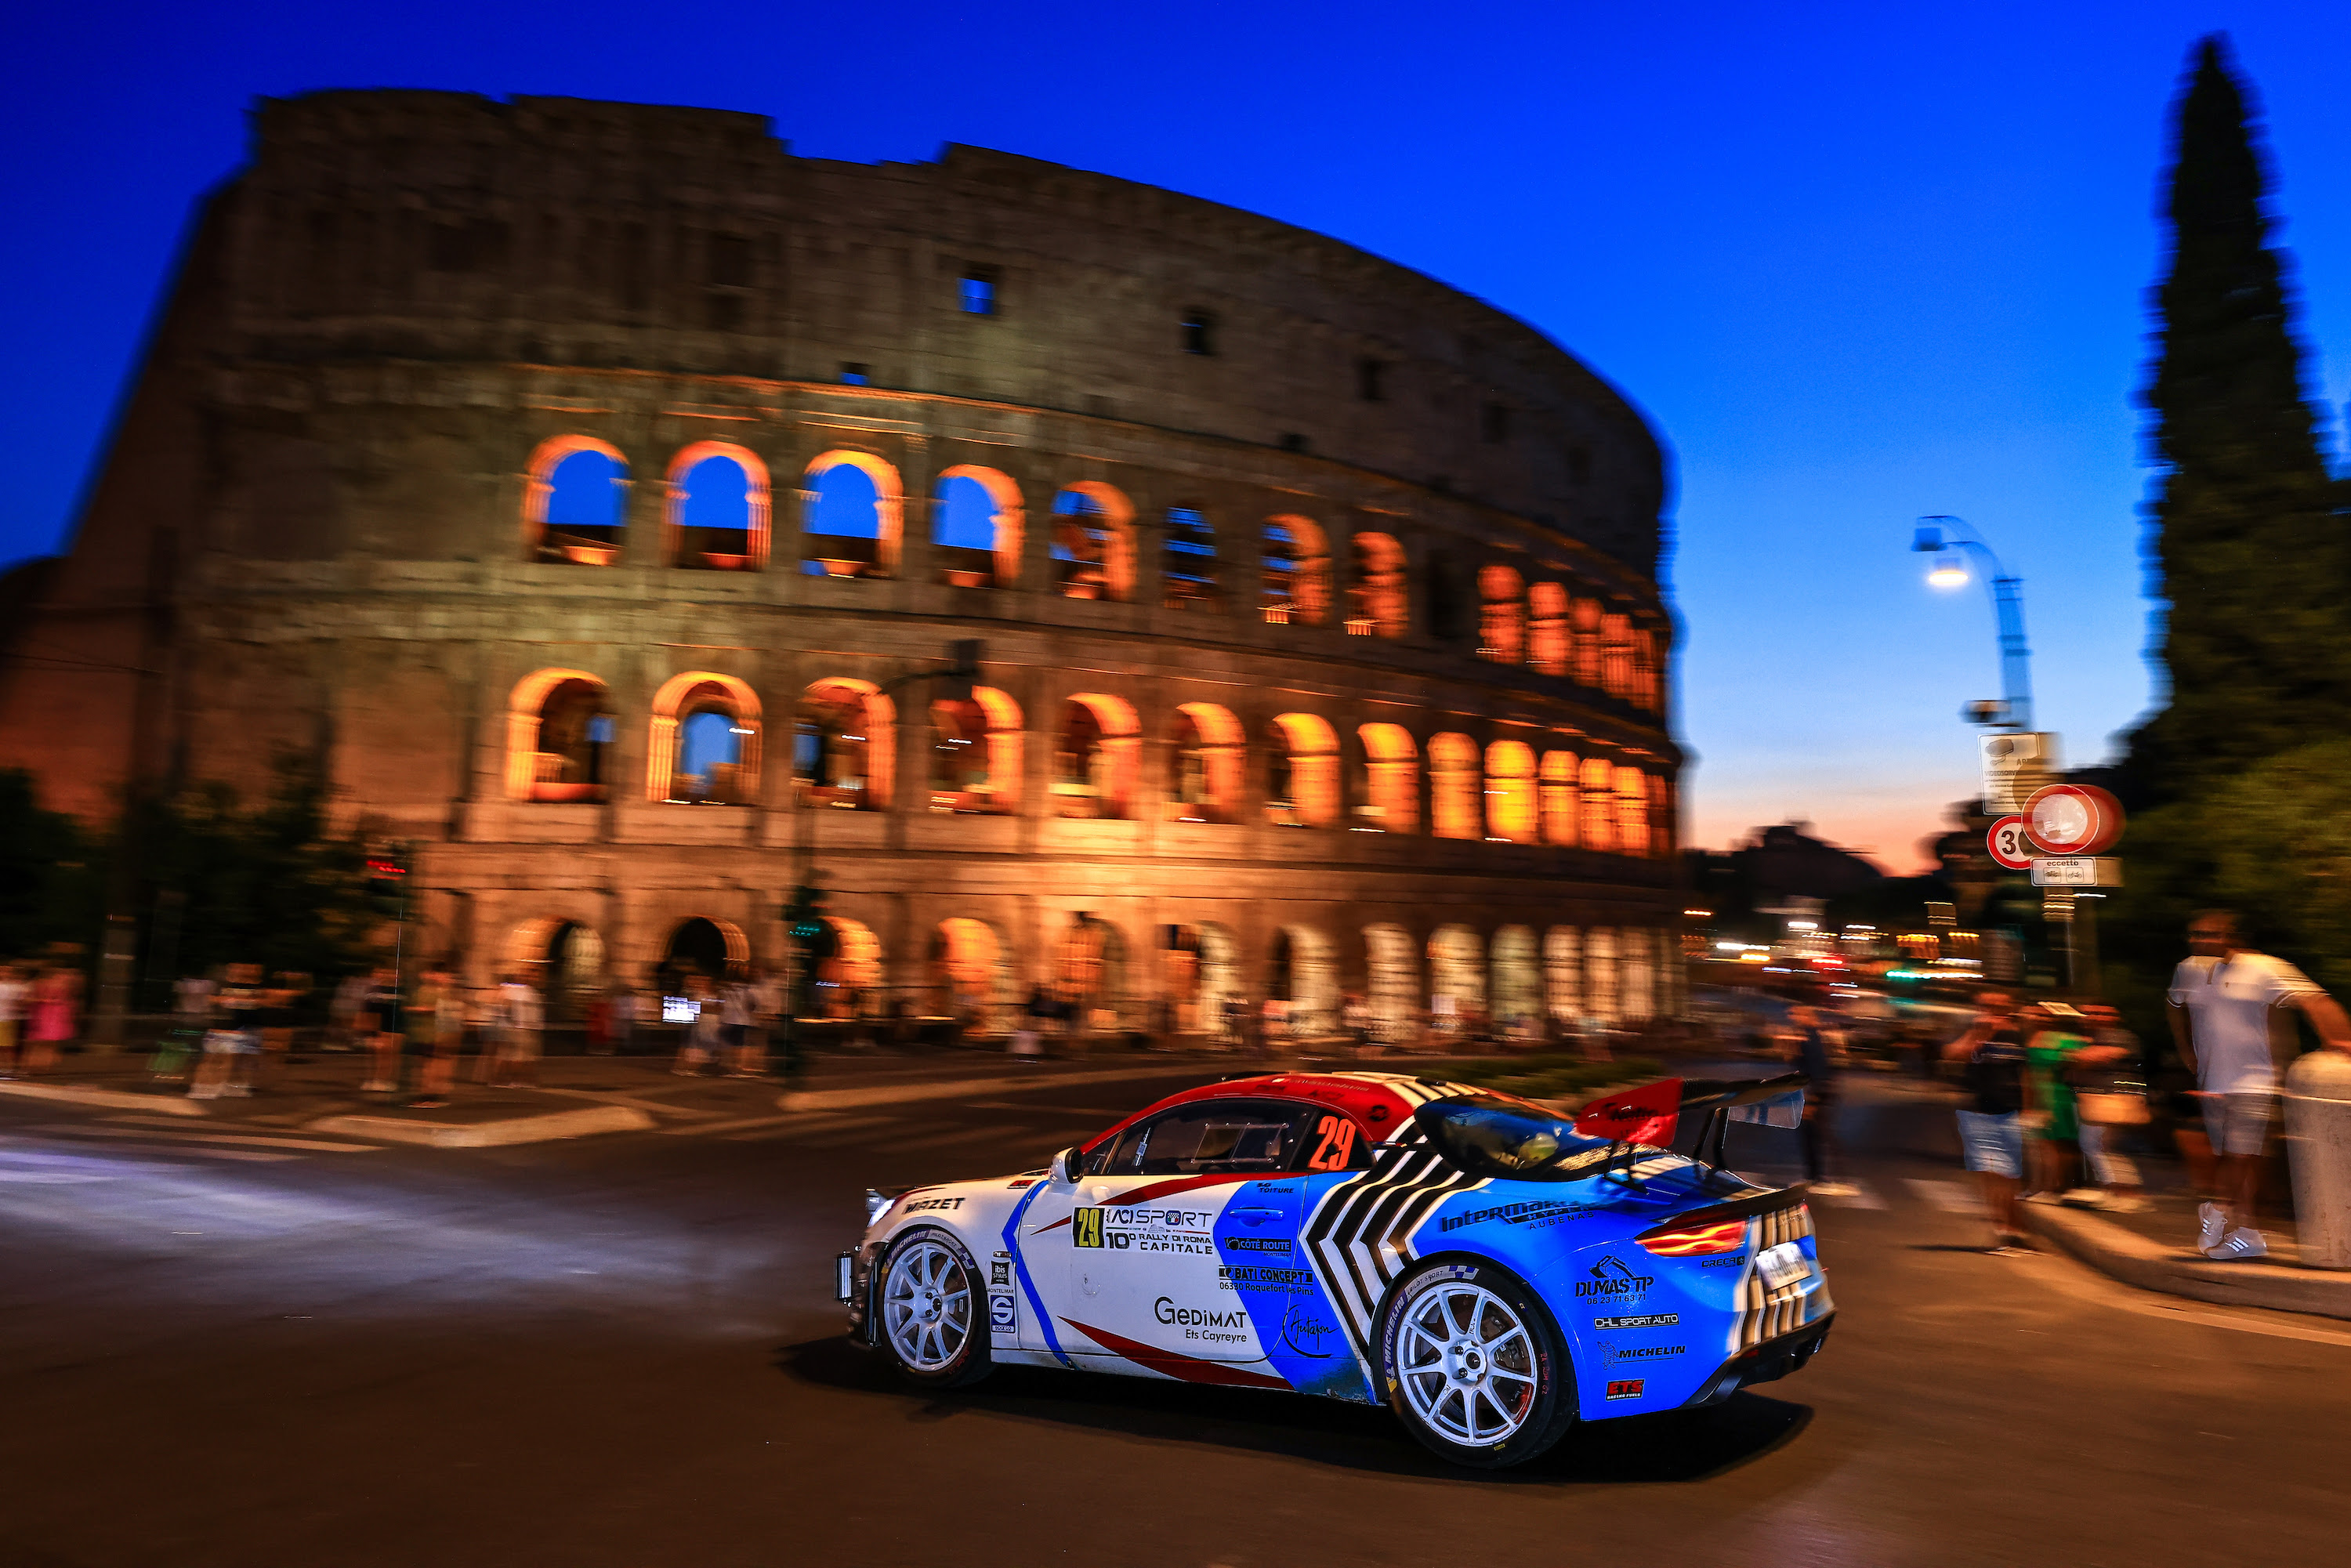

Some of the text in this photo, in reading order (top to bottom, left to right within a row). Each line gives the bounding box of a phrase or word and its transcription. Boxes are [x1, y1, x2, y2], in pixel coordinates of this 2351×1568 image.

[1308, 1116, 1356, 1171] 29
[901, 1197, 965, 1215] MAZET
[1136, 1209, 1212, 1227] SPORT
[1529, 1211, 1594, 1230] AUBENAS
[1078, 1208, 1099, 1247] 29
[891, 1230, 927, 1258] MICHELIN
[1140, 1242, 1213, 1255] CAPITALE
[1240, 1239, 1290, 1250] CÔTÉ ROUTE
[994, 1265, 1005, 1273] ibis
[1701, 1257, 1736, 1267] ORECA
[1235, 1268, 1304, 1283] BATI CONCEPT
[1409, 1270, 1444, 1292] PILOT SPORT
[1245, 1282, 1284, 1293] Roquefort
[1297, 1287, 1314, 1296] Pins
[1575, 1276, 1654, 1297] DUMAS TP
[1595, 1314, 1679, 1327] CHL SPORT AUTO
[1186, 1329, 1247, 1343] Ets Cayreyre
[1385, 1296, 1405, 1364] MICHELIN
[1619, 1345, 1686, 1358] MICHELIN
[1609, 1381, 1643, 1394] ETS
